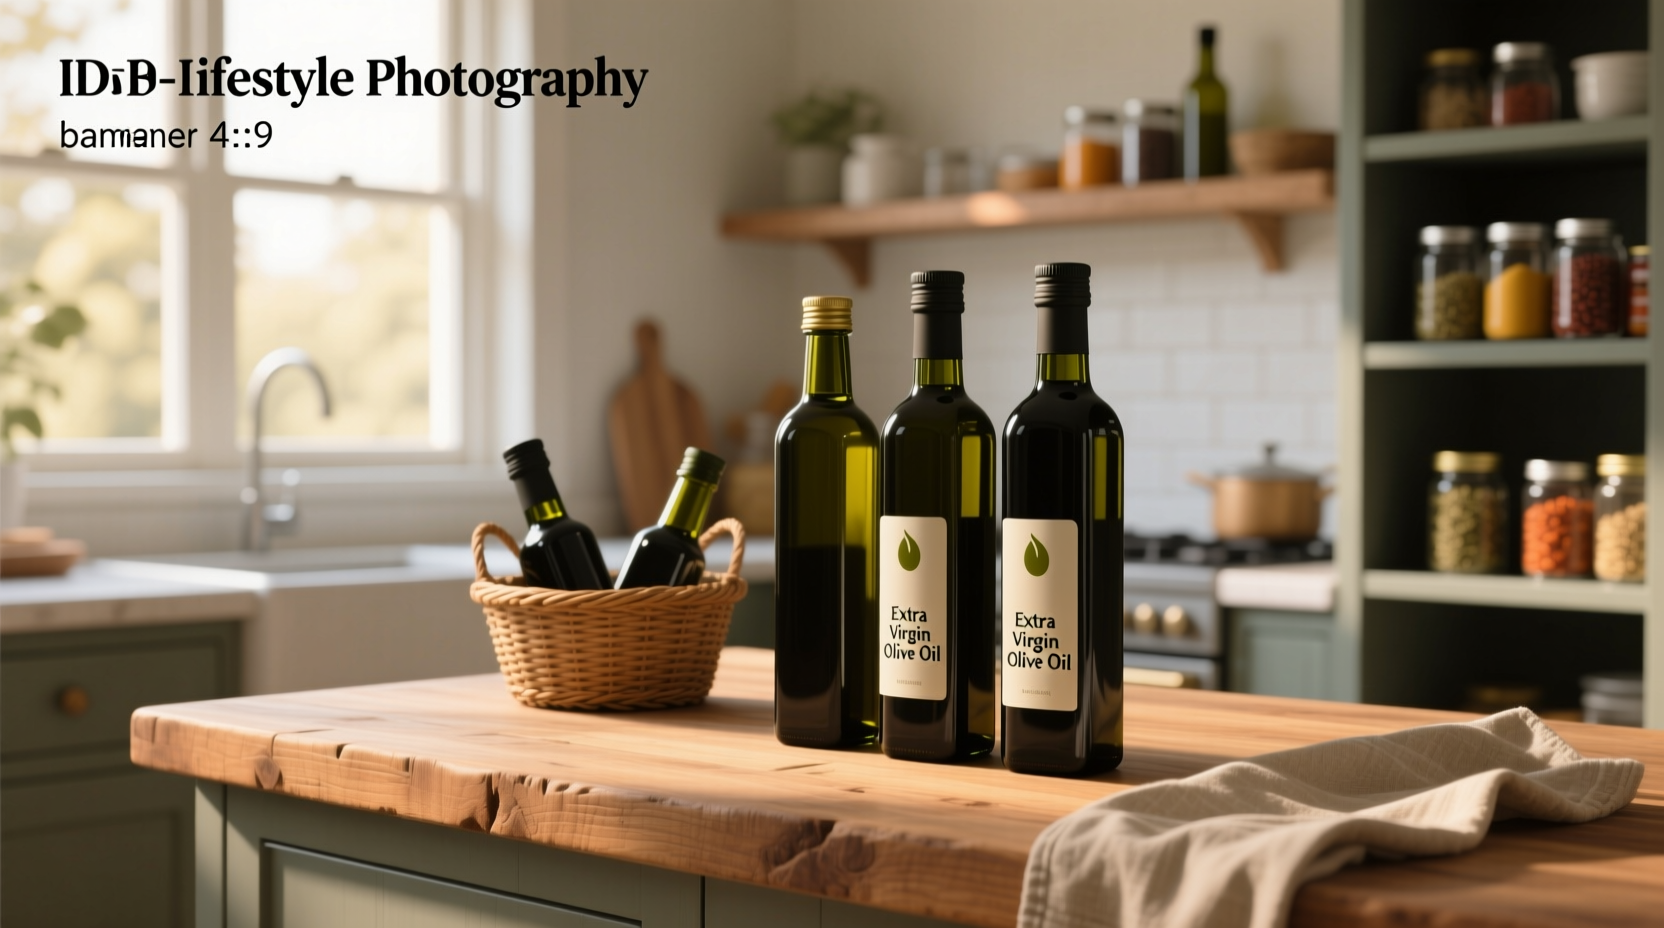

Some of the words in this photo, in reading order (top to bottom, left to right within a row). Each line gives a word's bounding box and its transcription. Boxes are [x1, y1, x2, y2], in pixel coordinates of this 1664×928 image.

[891, 605, 927, 622] Extra
[1015, 611, 1056, 629] Extra
[889, 624, 931, 645] Virgin
[1012, 631, 1059, 653] Virgin
[883, 642, 915, 661] Olive
[919, 644, 941, 662] Oil
[1007, 651, 1043, 669] Olive
[1047, 652, 1071, 671] Oil
